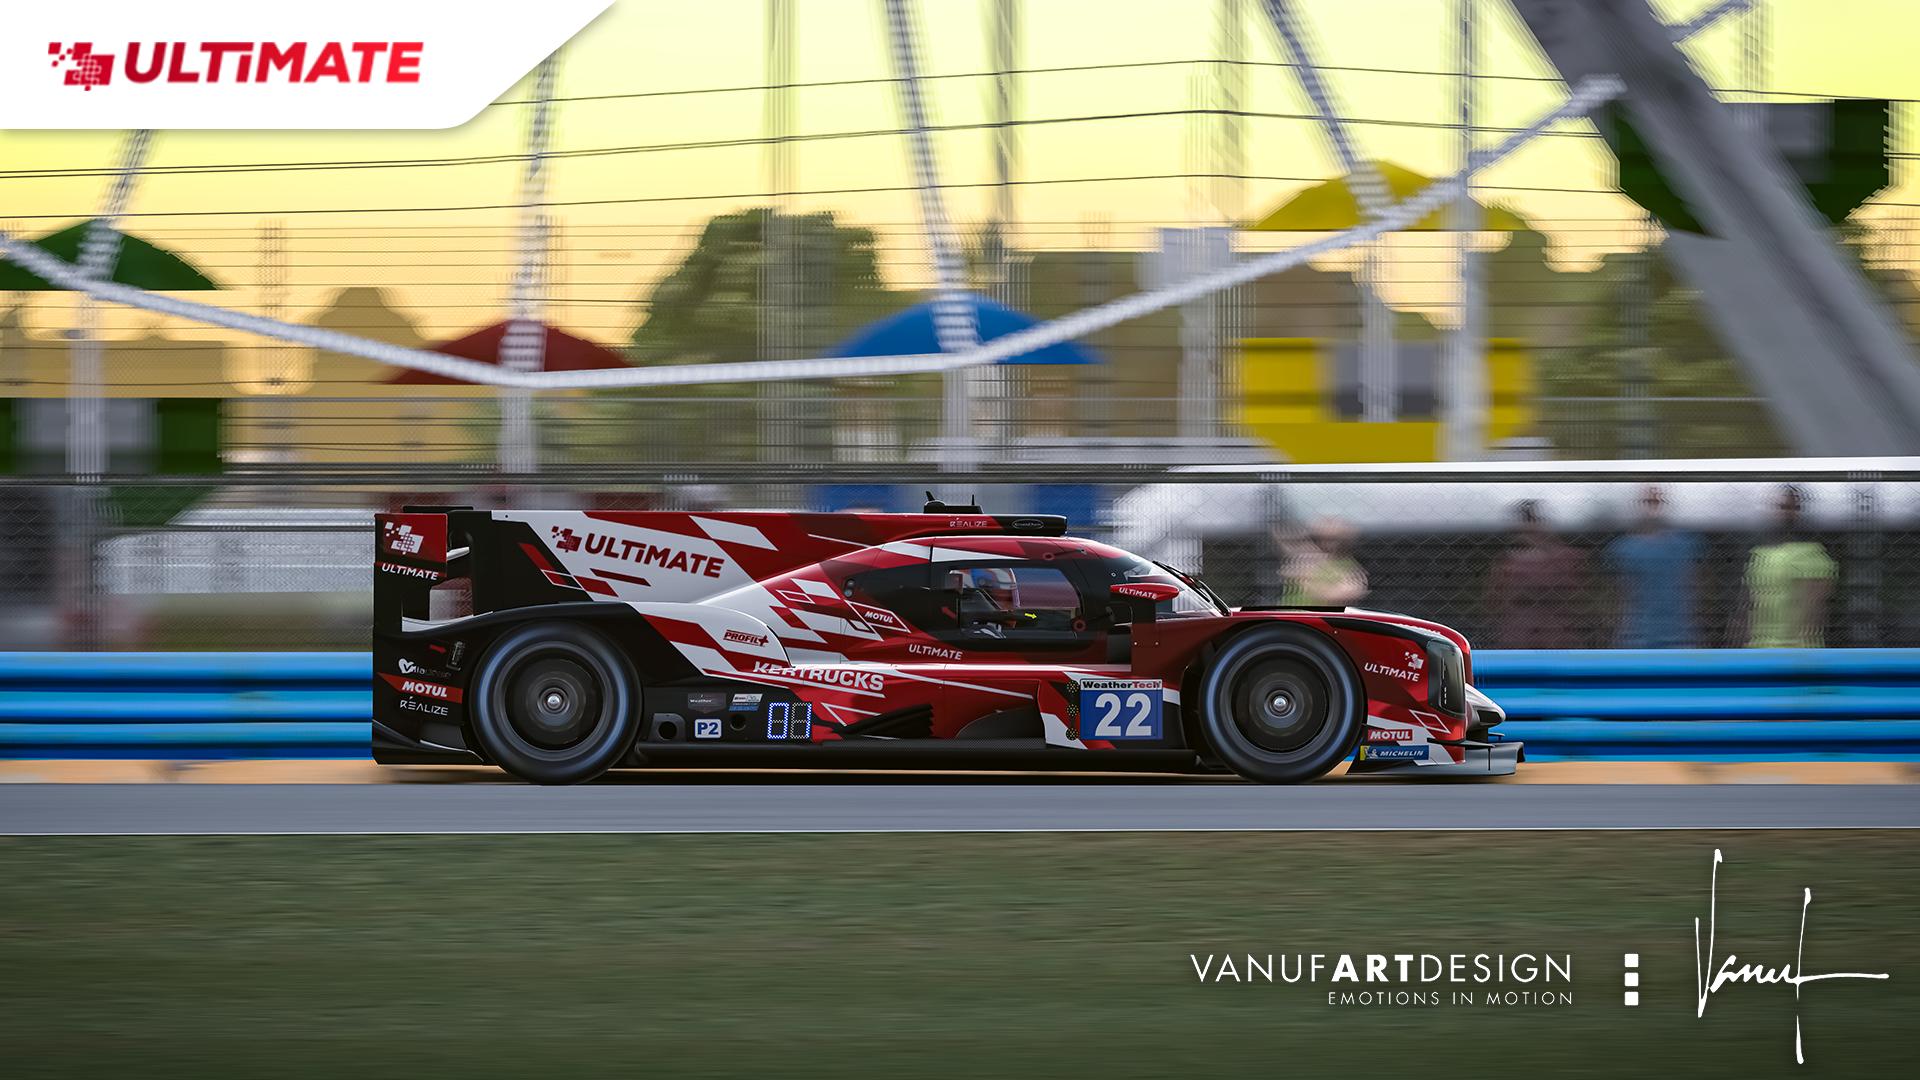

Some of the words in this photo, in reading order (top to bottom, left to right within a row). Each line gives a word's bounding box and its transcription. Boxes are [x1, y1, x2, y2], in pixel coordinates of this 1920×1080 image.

[864, 610, 894, 624] MOTUL
[401, 680, 448, 698] MOTUL
[1094, 692, 1152, 737] 22
[697, 722, 719, 735] P2
[1370, 731, 1411, 740] MOTUL
[1380, 749, 1424, 757] MICHELIN
